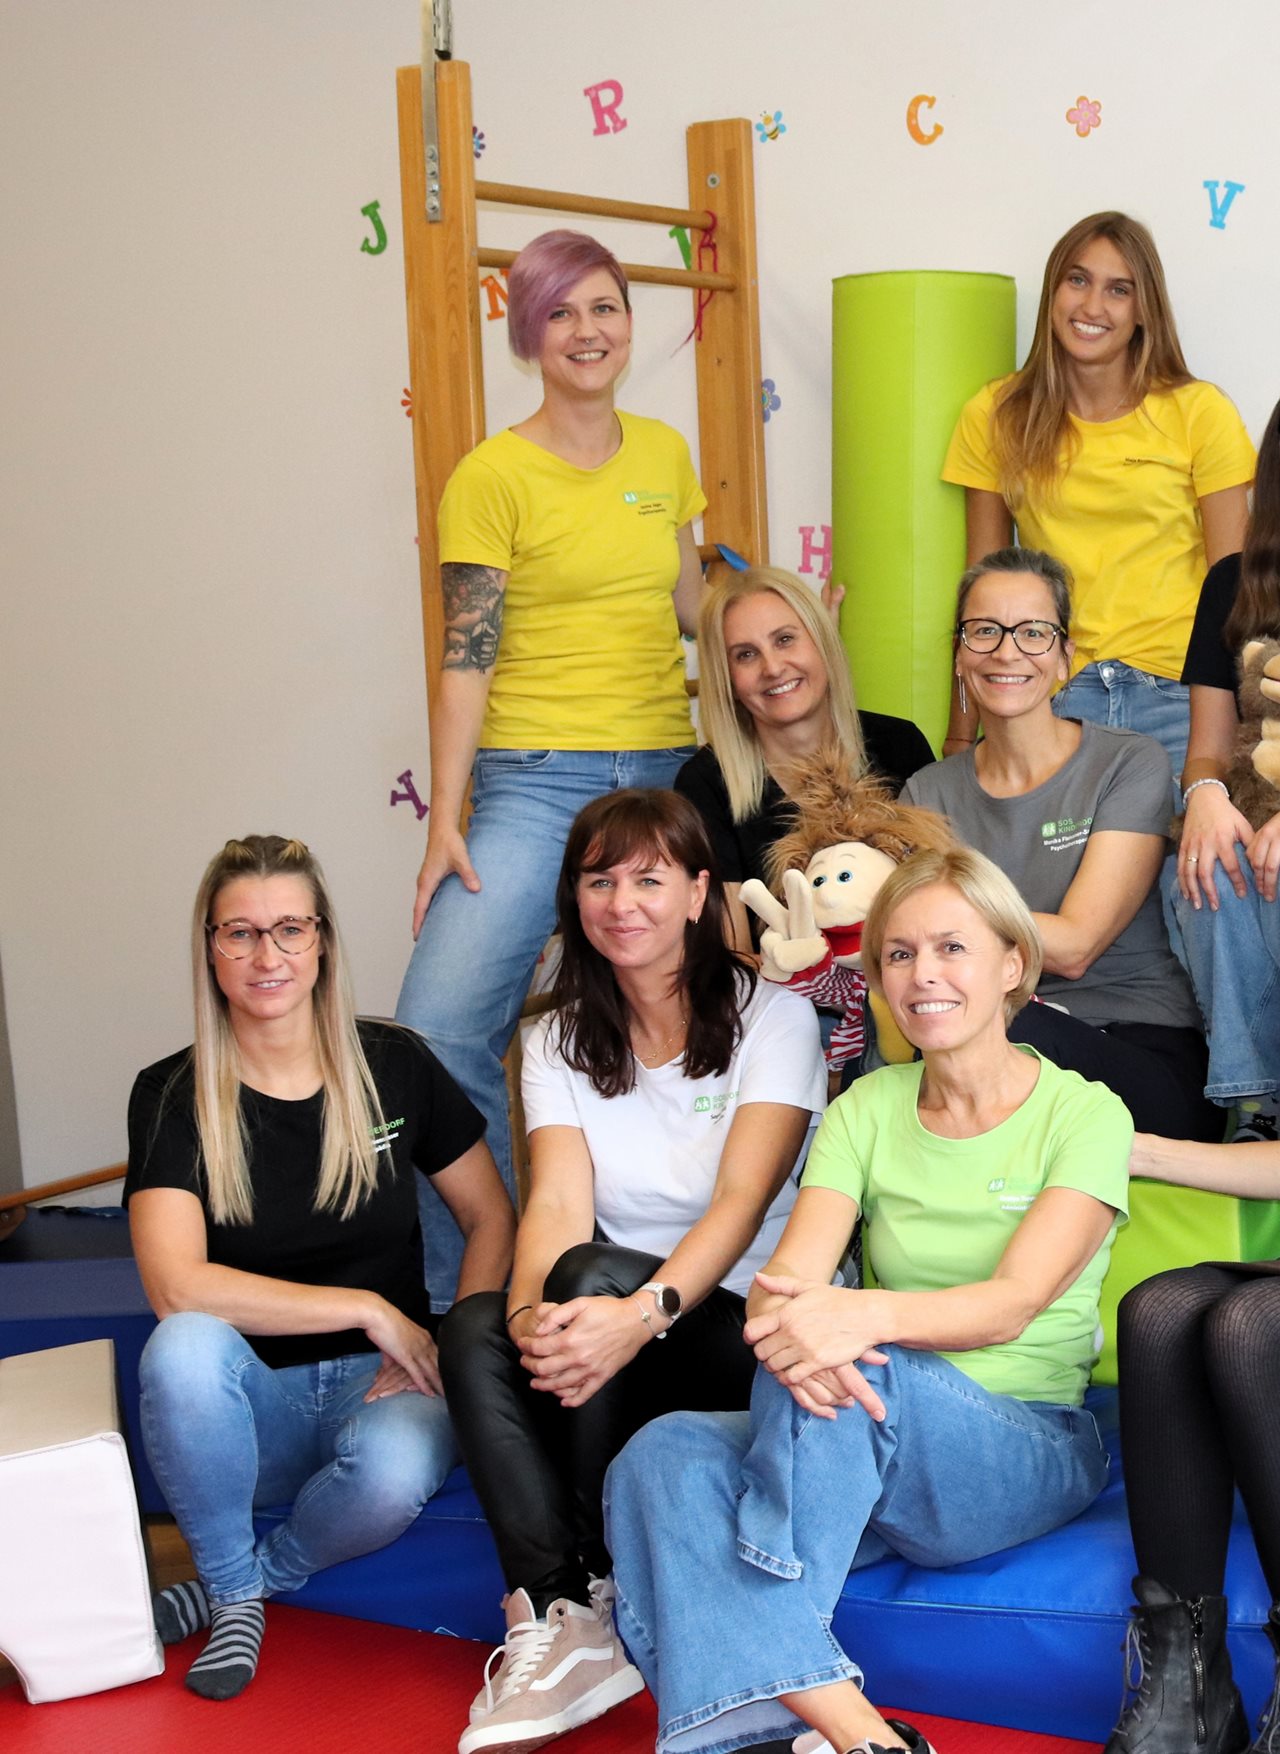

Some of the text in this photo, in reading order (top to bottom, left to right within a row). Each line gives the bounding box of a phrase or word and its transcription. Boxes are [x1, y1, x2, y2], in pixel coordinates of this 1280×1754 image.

[583, 79, 628, 136] R
[906, 95, 944, 145] C
[360, 199, 388, 256] J
[1203, 180, 1245, 229] V
[798, 524, 833, 580] H
[390, 769, 429, 821] Y
[1057, 818, 1074, 827] SOS
